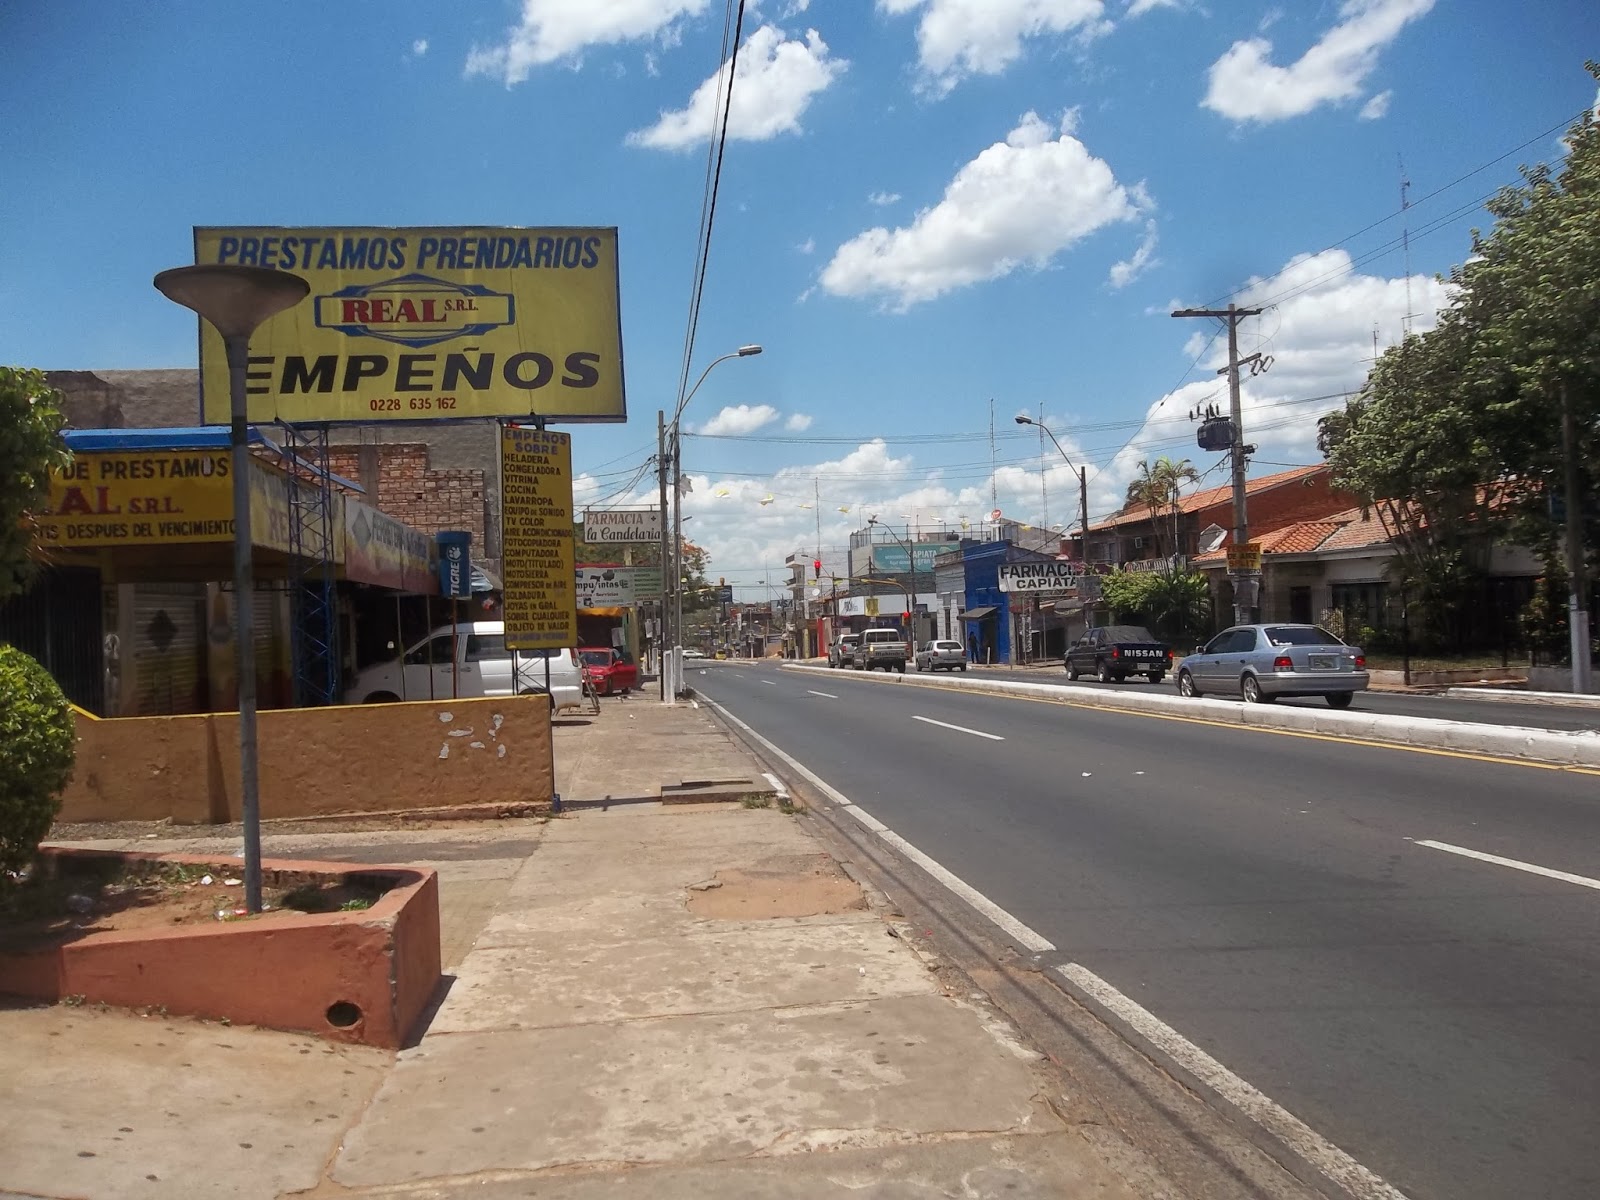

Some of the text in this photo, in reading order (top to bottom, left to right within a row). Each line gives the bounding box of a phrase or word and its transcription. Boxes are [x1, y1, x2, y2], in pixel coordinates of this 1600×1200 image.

[217, 236, 600, 270] PRESTAMOS PRENDARIOS
[341, 298, 479, 324] REAL S.R.L.
[246, 346, 601, 394] EMPEÑOS
[369, 397, 457, 412] 0228 635 162
[515, 443, 558, 455] SOBRE
[504, 453, 550, 464] HELADERA
[63, 457, 229, 480] DE PRESTAMOS
[504, 463, 561, 475] CONGELADORA
[504, 475, 539, 485] VITRINA
[504, 485, 537, 495] COCINA
[55, 486, 121, 516] AL
[504, 496, 553, 506] LAVARROPA
[504, 506, 530, 515] EQUIPO
[538, 507, 565, 517] SONIDO
[506, 517, 545, 527] TV COLOR
[586, 513, 644, 525] FARMACIA
[67, 523, 129, 539] DESPUES
[133, 522, 153, 537] DEL
[504, 527, 520, 536] AIRE
[587, 527, 661, 541] la Candelaria
[504, 538, 561, 547] FOTOCOPIADORA
[504, 549, 559, 558] COMPUTADORA
[450, 562, 460, 596] TIGRE
[506, 570, 549, 579] MOTOSIERRA
[505, 580, 545, 589] COMPRESOR
[505, 591, 547, 600] SOLDADURA
[505, 601, 528, 610] JOYAS
[506, 611, 570, 621] SOBRE CUALQUIER
[507, 622, 535, 631] OBJETO
[547, 621, 570, 630] VALOR
[1123, 649, 1164, 658] NISSAN
